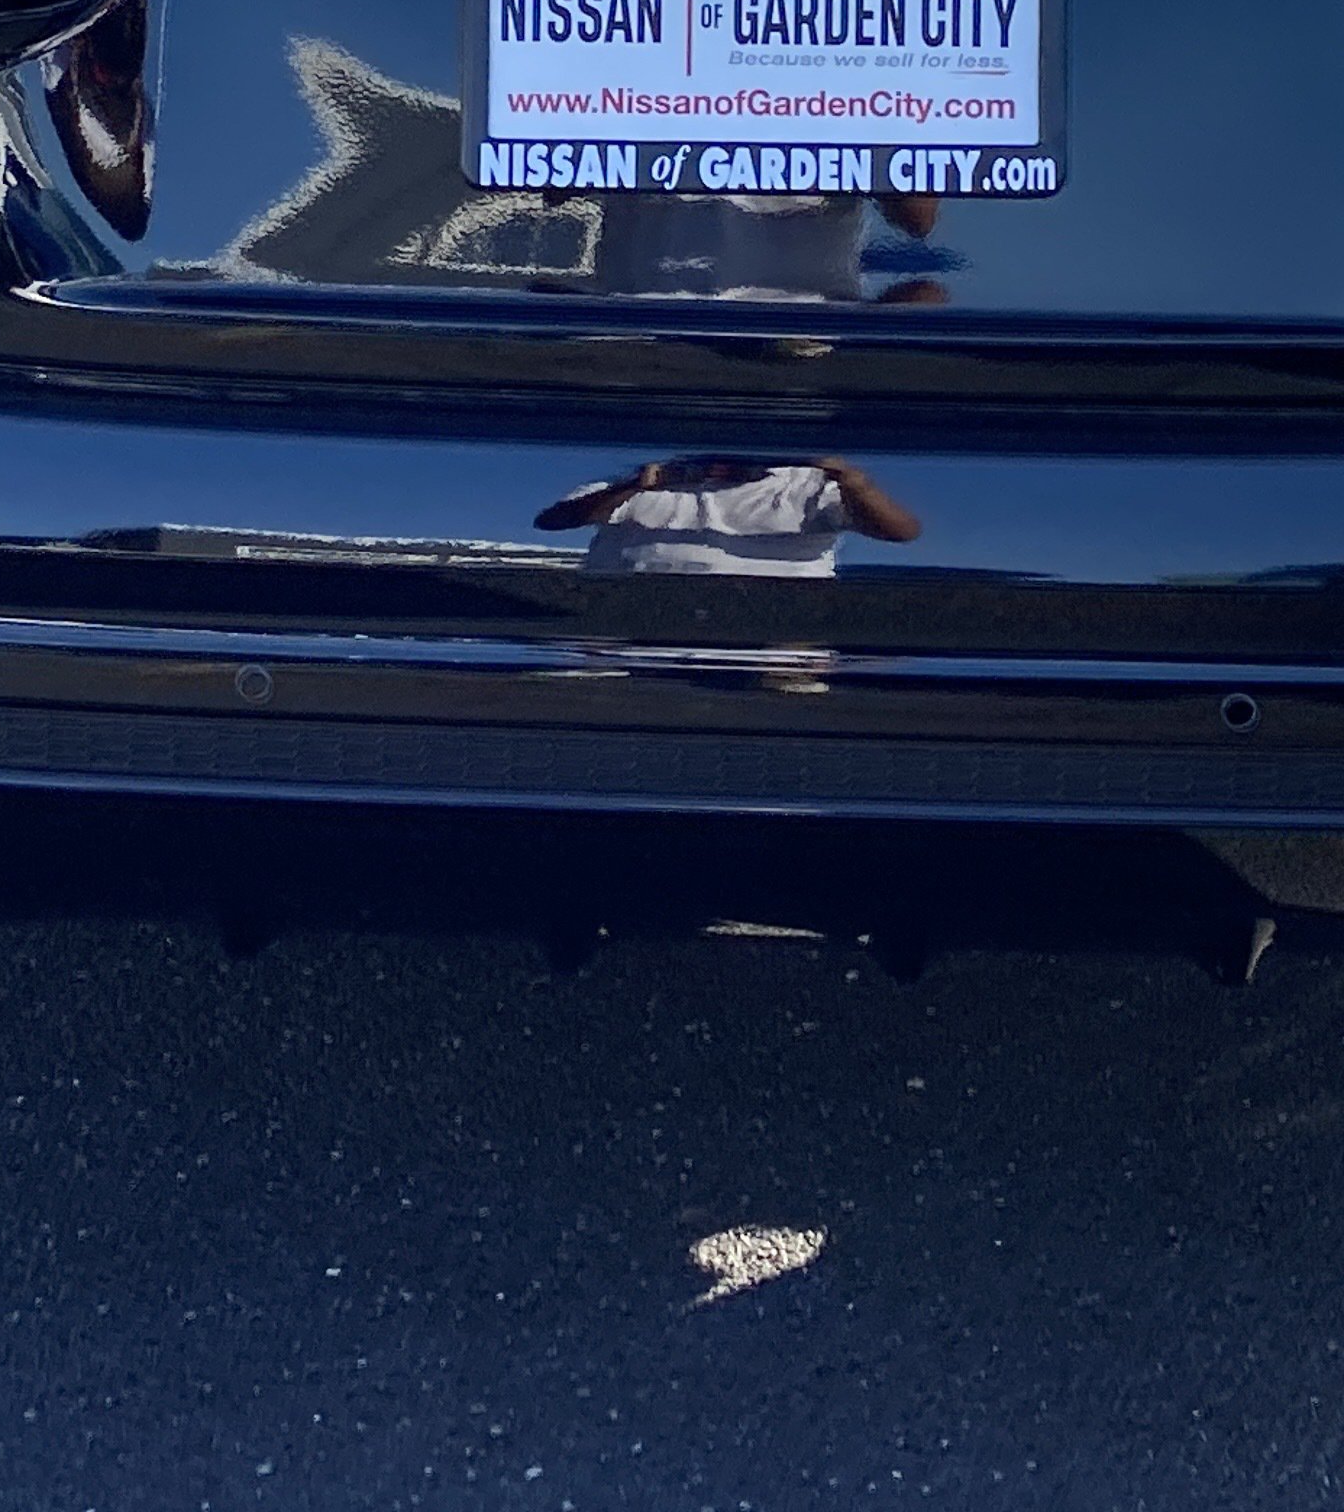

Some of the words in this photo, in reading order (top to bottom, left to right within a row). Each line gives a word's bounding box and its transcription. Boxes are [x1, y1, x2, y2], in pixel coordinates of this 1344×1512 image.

[700, 4, 723, 29] OF
[728, 50, 826, 67] Because
[833, 55, 867, 68] we
[874, 52, 914, 68] sell
[919, 52, 951, 69] for
[956, 53, 1010, 69] less.
[507, 88, 1017, 123] www.NissanofGardenCity.com
[479, 143, 637, 188] NISSAN
[651, 145, 689, 189] of
[698, 146, 873, 192] GARDEN
[889, 151, 1056, 193] CITY.com
